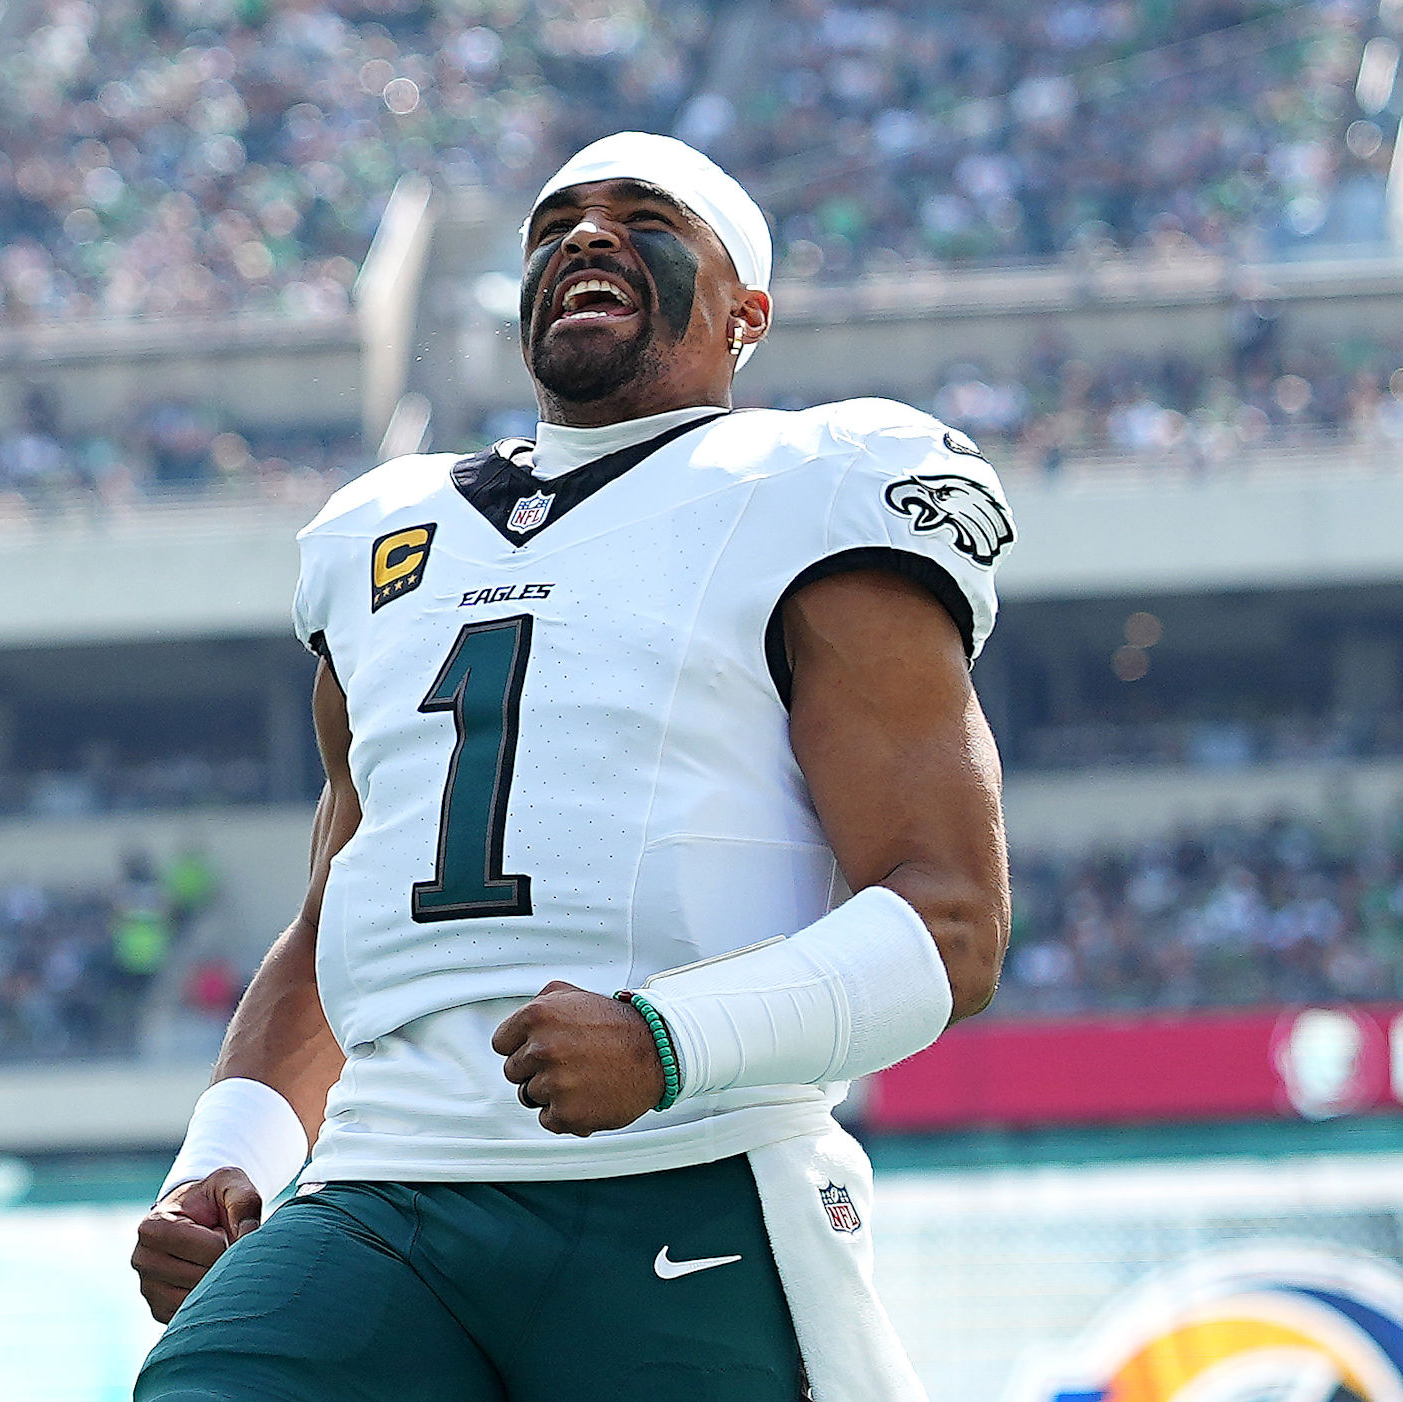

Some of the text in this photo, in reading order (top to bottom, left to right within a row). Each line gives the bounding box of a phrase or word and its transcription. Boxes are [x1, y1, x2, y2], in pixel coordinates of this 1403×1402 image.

[514, 509, 541, 527] NFL
[374, 527, 429, 589] C
[458, 583, 556, 608] EAGLES
[411, 613, 533, 923] 1
[827, 1204, 859, 1230] NFL
